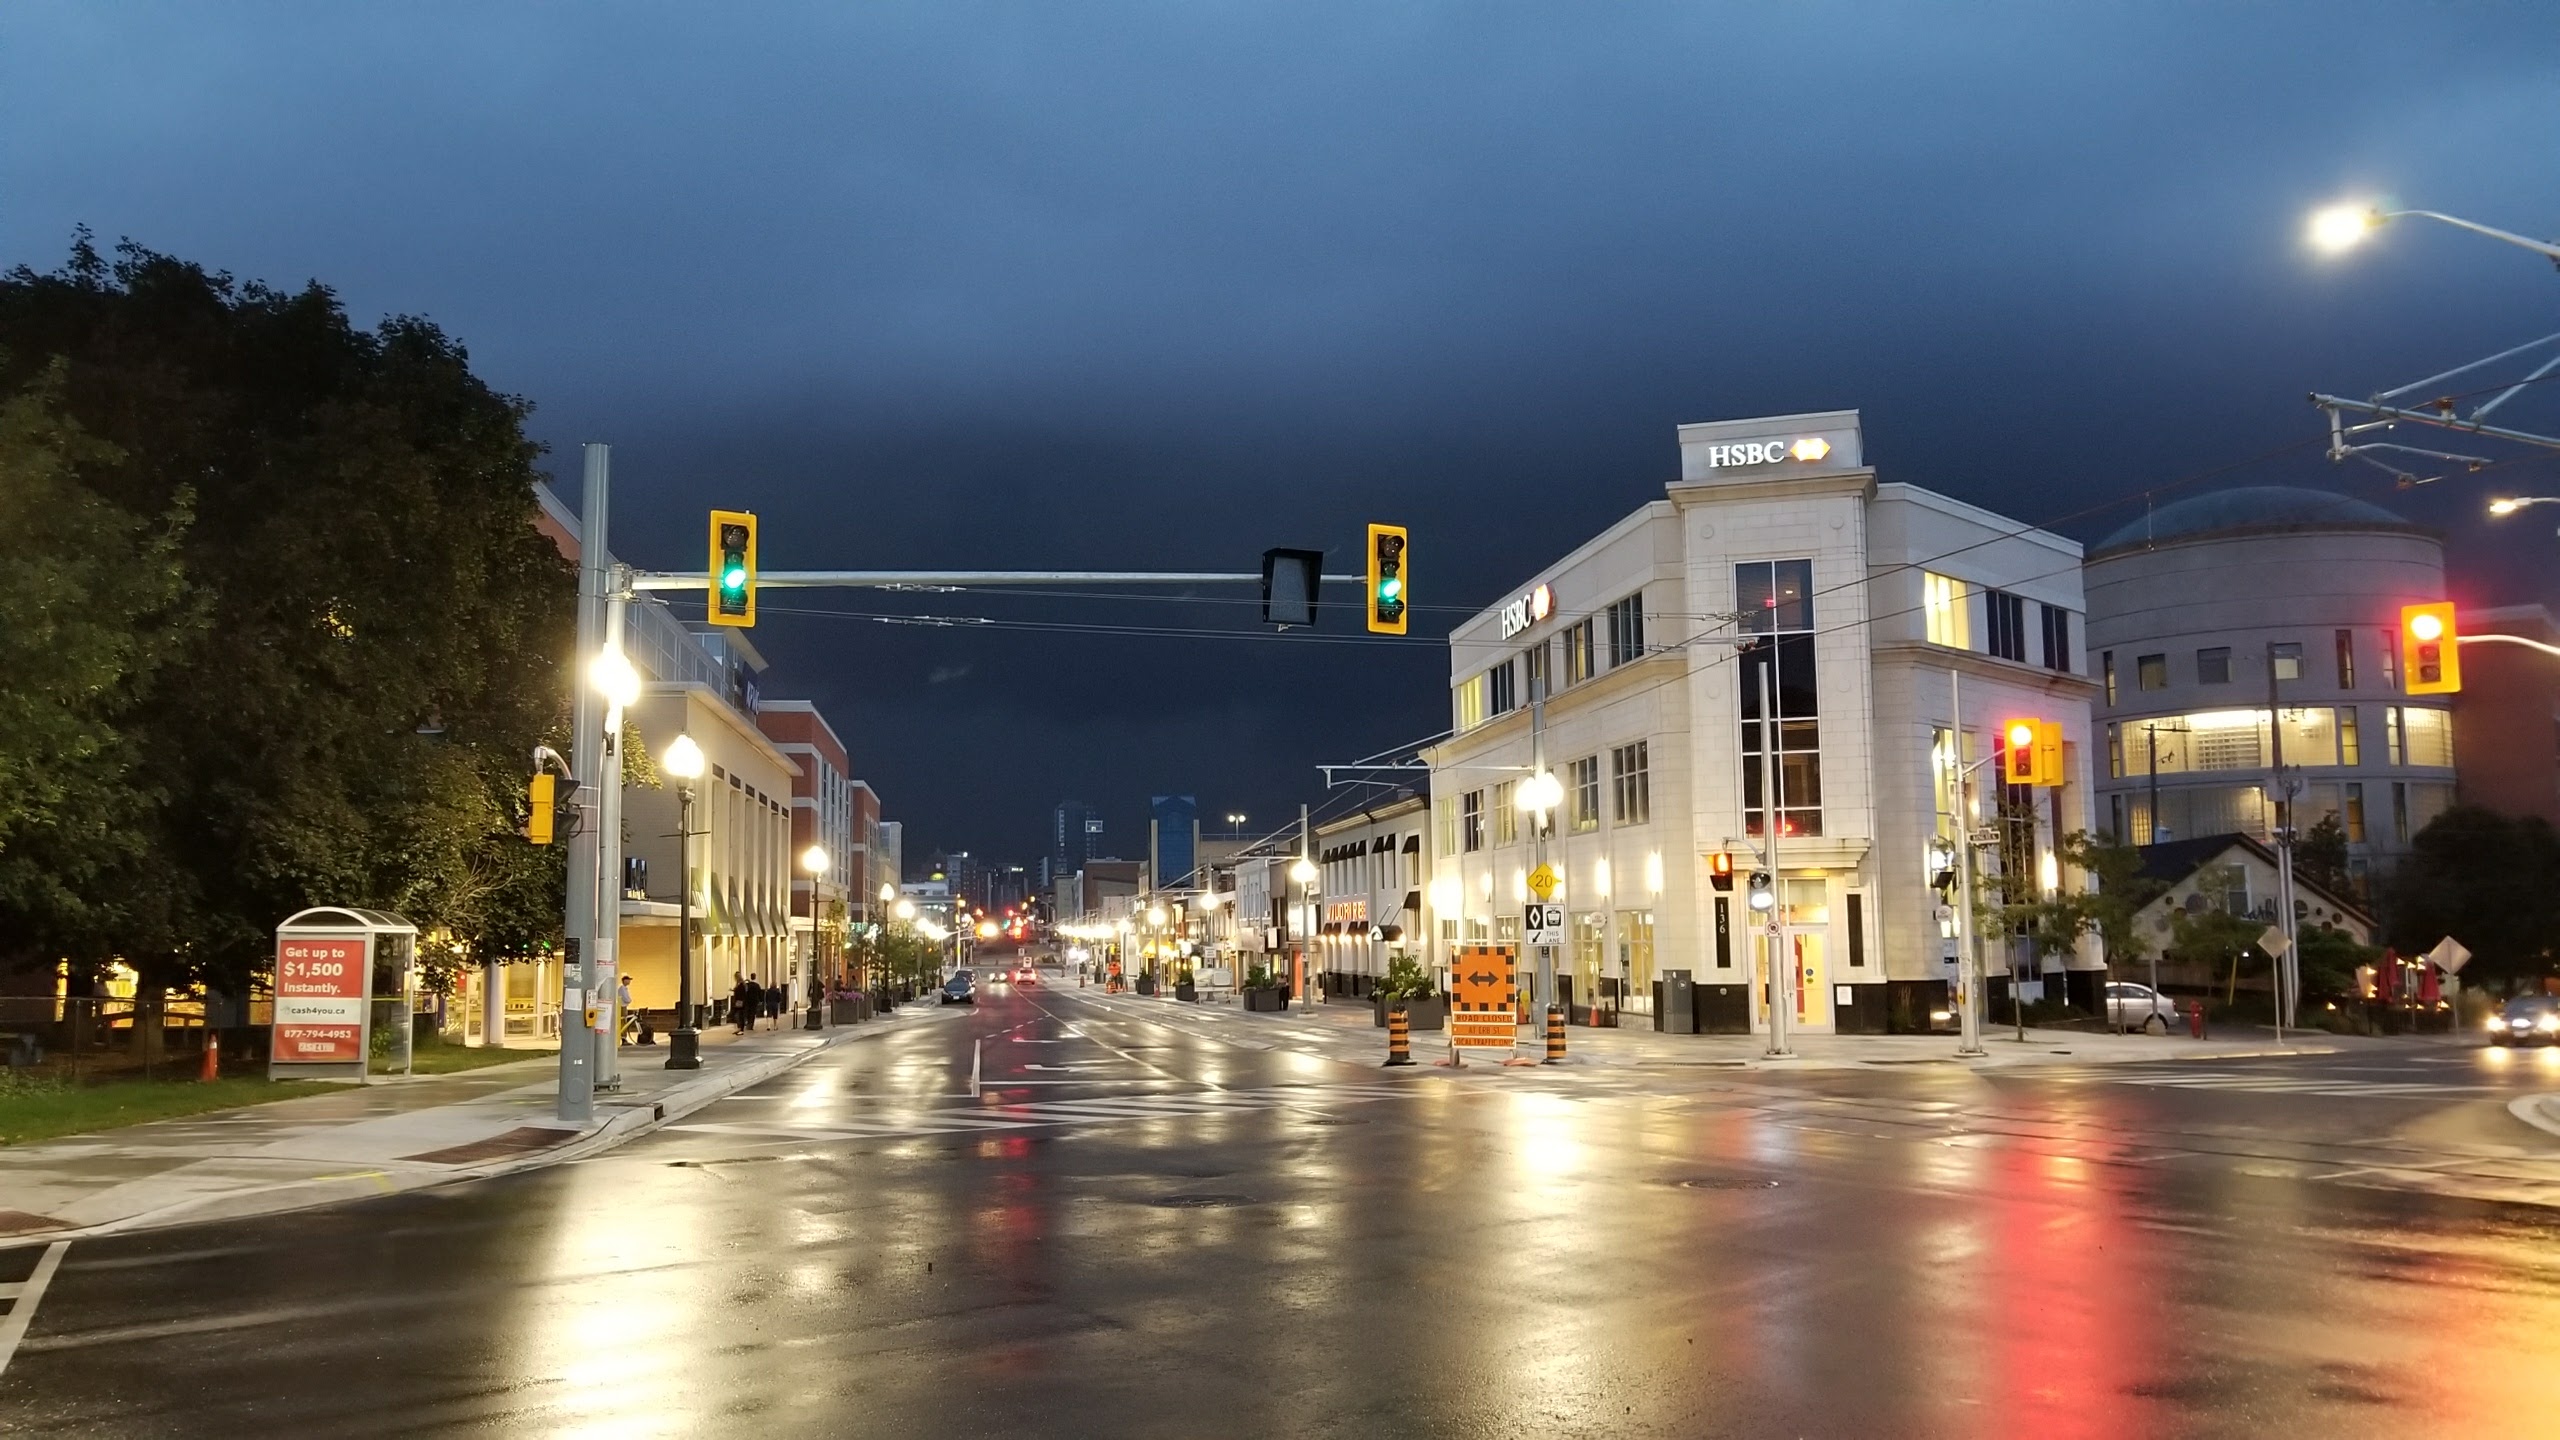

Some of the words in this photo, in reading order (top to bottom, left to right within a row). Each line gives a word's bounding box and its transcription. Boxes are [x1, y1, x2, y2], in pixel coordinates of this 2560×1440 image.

[1708, 441, 1785, 468] HSBC
[1500, 594, 1533, 641] HSBC
[1535, 874, 1553, 888] 20
[285, 947, 308, 958] Get
[312, 949, 328, 960] up
[331, 948, 346, 958] to
[284, 961, 344, 979] $1,500
[284, 982, 341, 996] Instantly.
[291, 1006, 346, 1016] cash4you.ca
[1456, 1014, 1479, 1022] ROAD
[1482, 1014, 1513, 1023] CLOSED
